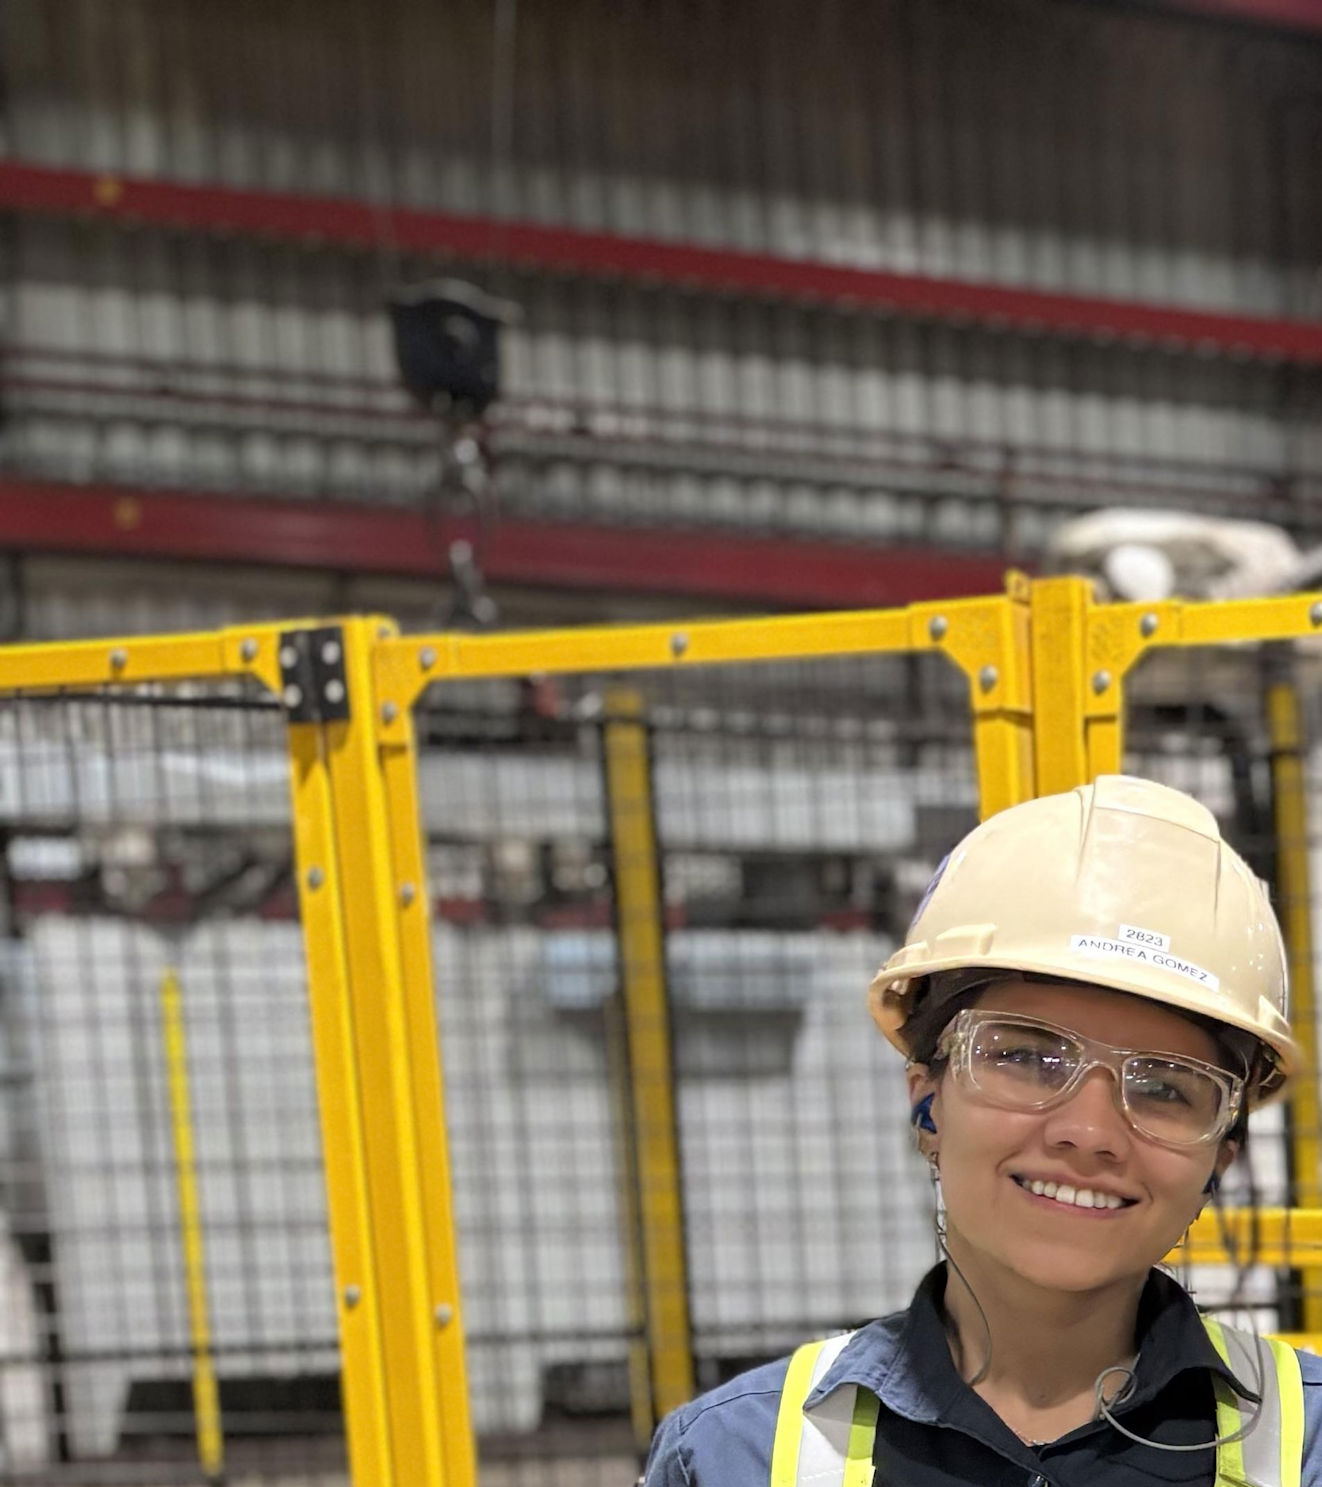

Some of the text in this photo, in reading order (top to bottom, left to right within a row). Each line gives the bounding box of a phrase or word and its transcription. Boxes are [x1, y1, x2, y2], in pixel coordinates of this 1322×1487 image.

[1126, 928, 1164, 947] 2823
[1078, 939, 1208, 982] ANDREA GOMEZ
